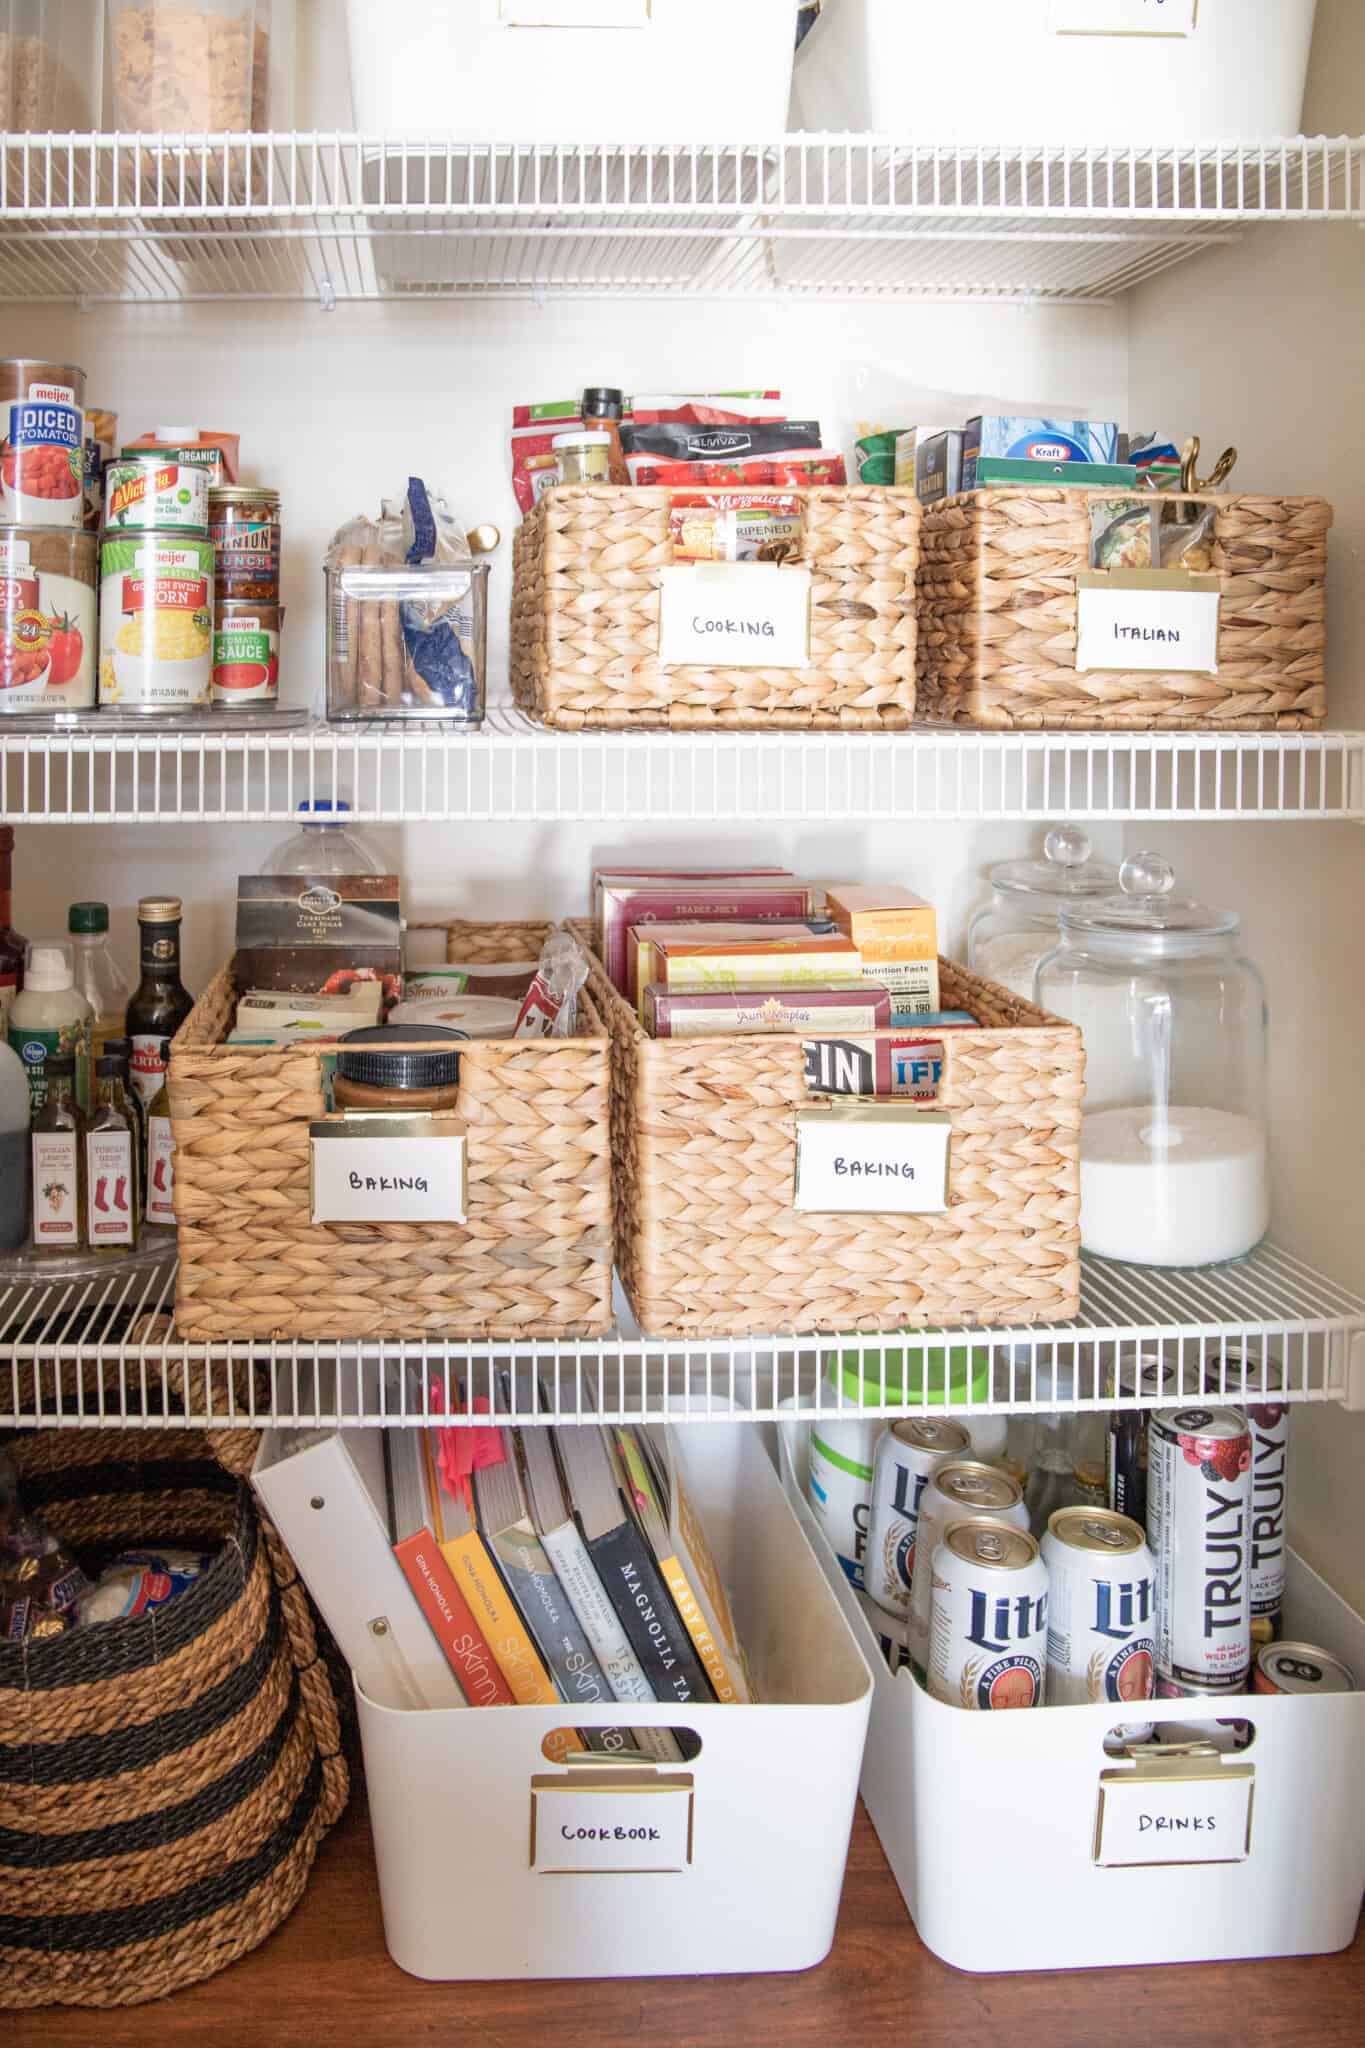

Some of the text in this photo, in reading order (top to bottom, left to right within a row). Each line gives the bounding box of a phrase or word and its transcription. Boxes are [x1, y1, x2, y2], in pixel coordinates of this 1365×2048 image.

[36, 388, 70, 402] meijer
[23, 410, 76, 432] DICED
[179, 450, 216, 461] ORGANIC
[1035, 447, 1061, 458] Kraft
[736, 524, 792, 537] RIPENED
[155, 591, 188, 604] ORN
[692, 616, 775, 638] COOKING
[1113, 623, 1181, 642] ITALIAN
[217, 646, 264, 660] SAUCE
[862, 965, 929, 976] Nutrition Facts
[834, 1158, 915, 1180] BAKING
[349, 1172, 428, 1193] BAKING
[1117, 1474, 1126, 1512] ELTZER
[1251, 1433, 1286, 1569] TRULY
[1204, 1488, 1243, 1638] TRULY
[415, 1553, 454, 1623] GINA HOMOLKA
[619, 1562, 676, 1670] MAGNOLIA
[672, 1578, 724, 1680] EASY KETO
[1111, 1645, 1135, 1669] FINE
[1204, 1652, 1227, 1662] WILD
[985, 1659, 1011, 1681] FINE
[561, 1825, 661, 1841] COOKBOOK
[1138, 1814, 1216, 1832] DRINKS
